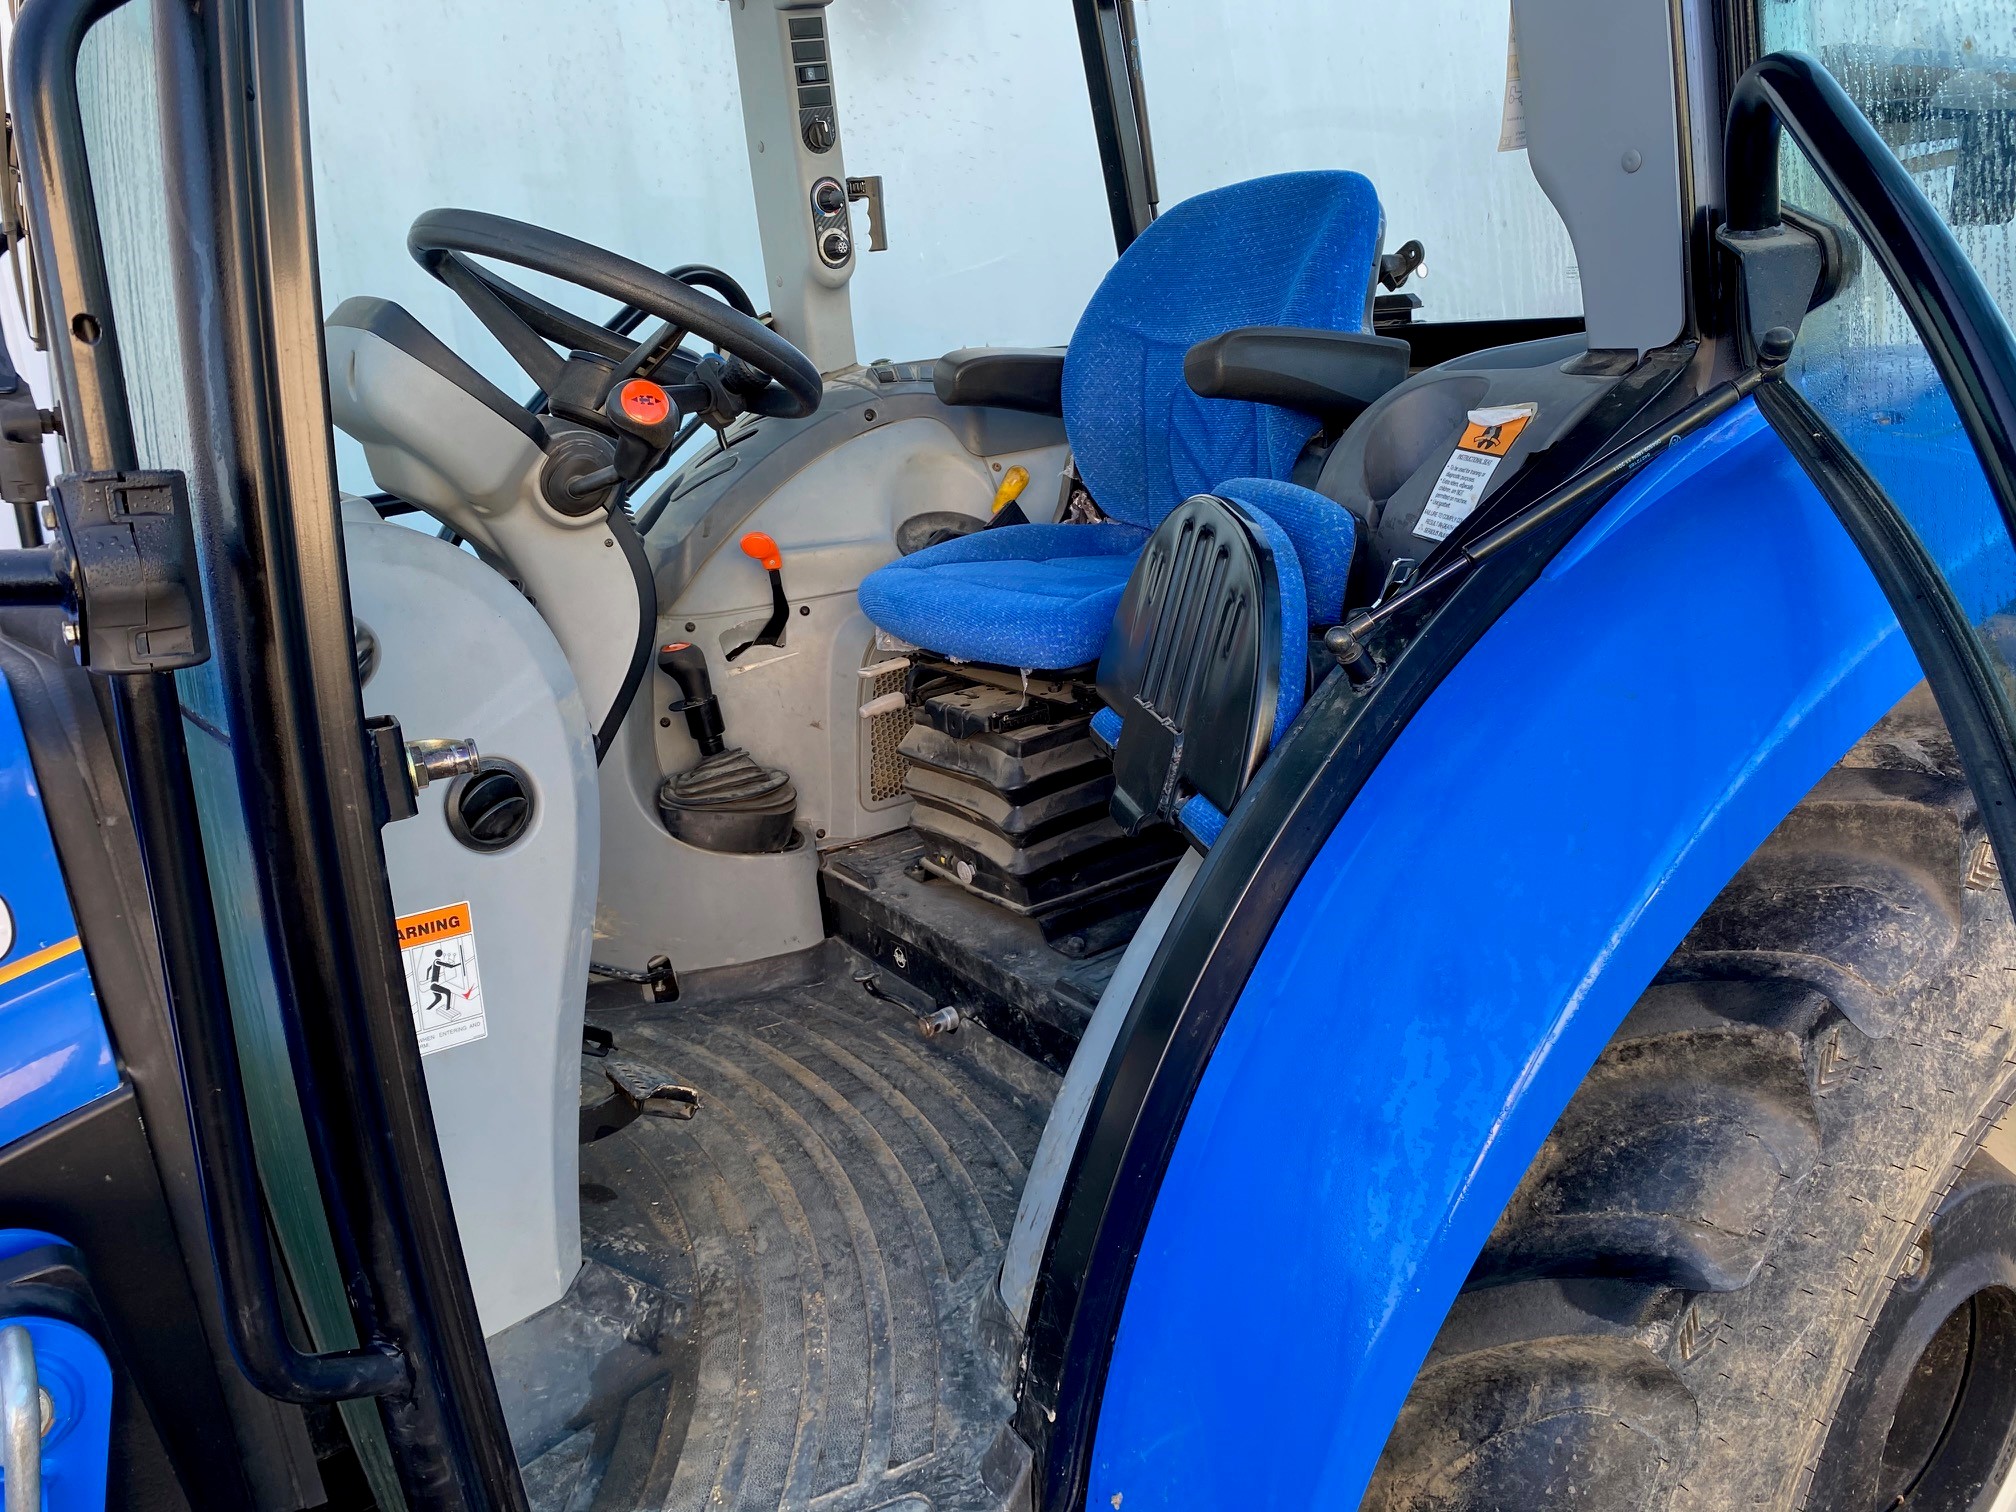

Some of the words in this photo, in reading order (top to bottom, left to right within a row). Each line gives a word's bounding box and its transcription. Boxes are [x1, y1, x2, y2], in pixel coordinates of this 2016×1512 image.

[398, 916, 460, 940] ARNING
[438, 1026, 467, 1038] ENTERING
[469, 1021, 481, 1029] AND
